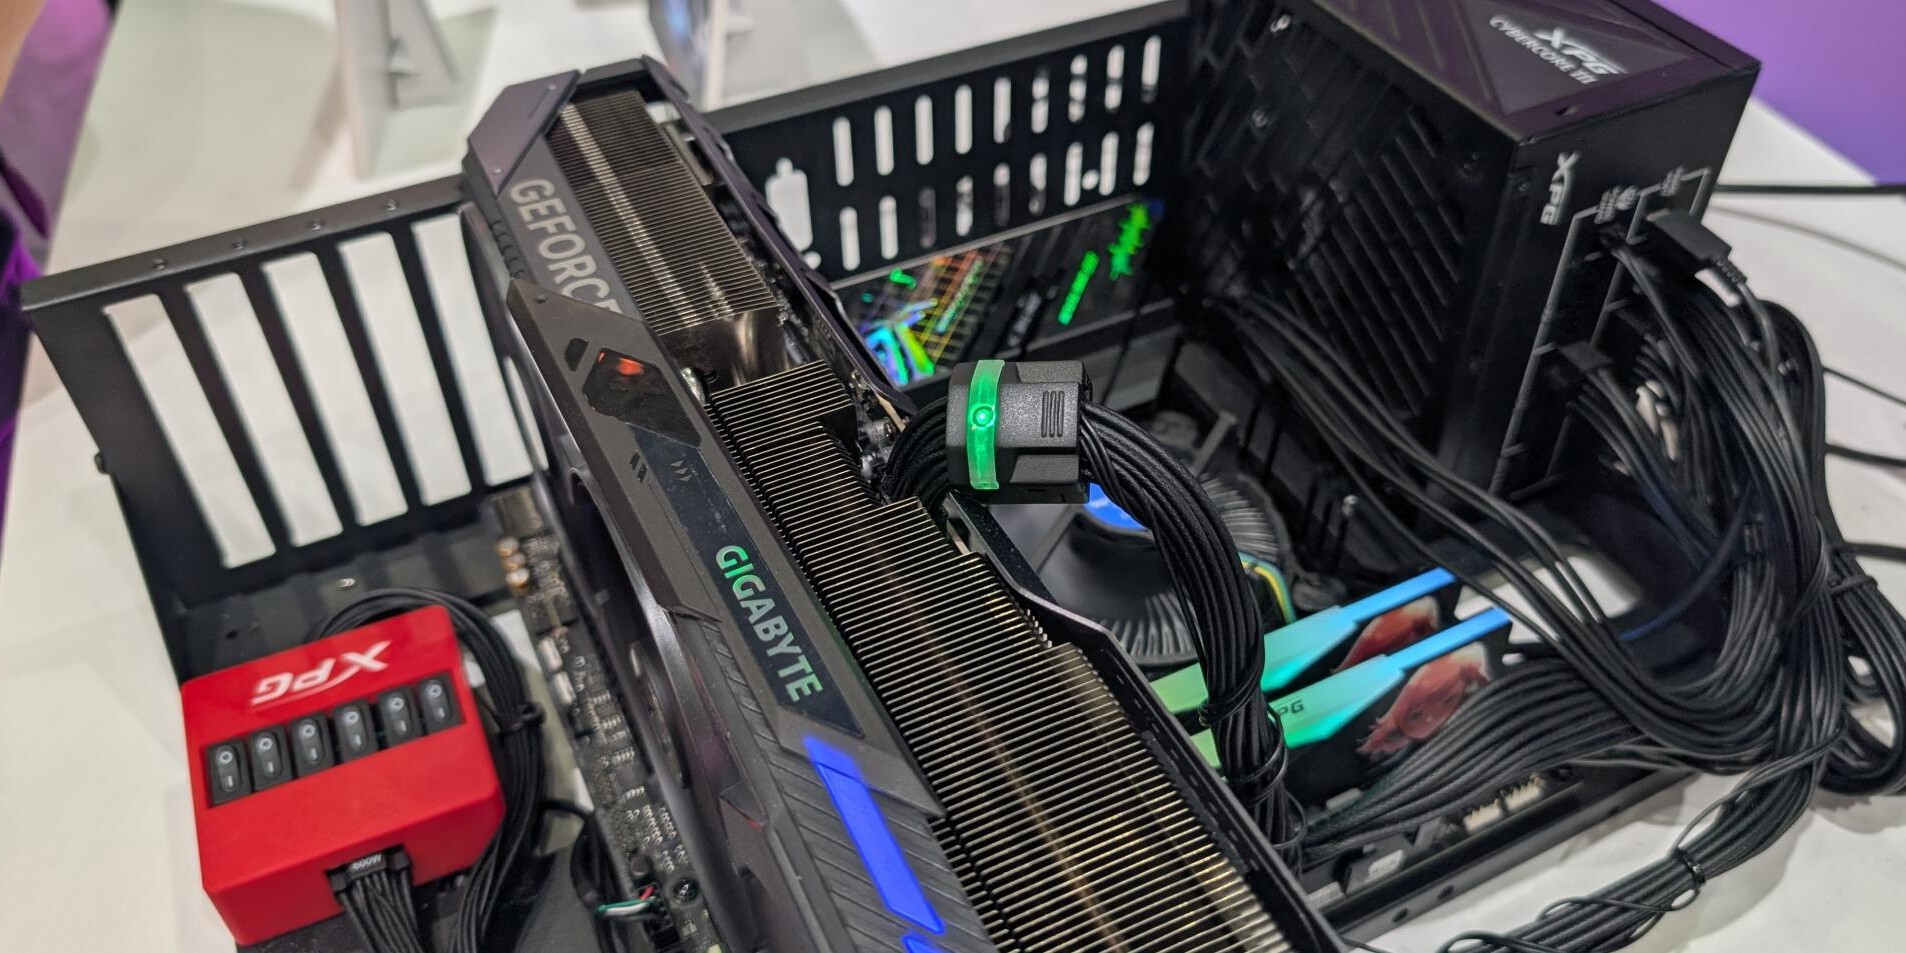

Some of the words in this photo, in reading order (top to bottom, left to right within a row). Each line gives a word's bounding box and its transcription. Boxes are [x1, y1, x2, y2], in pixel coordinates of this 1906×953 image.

[1490, 15, 1578, 73] CYBERCORE
[1533, 27, 1628, 74] XPG
[1540, 152, 1580, 225] XPG
[715, 545, 823, 702] GIGABYTE
[252, 640, 392, 706] XPG
